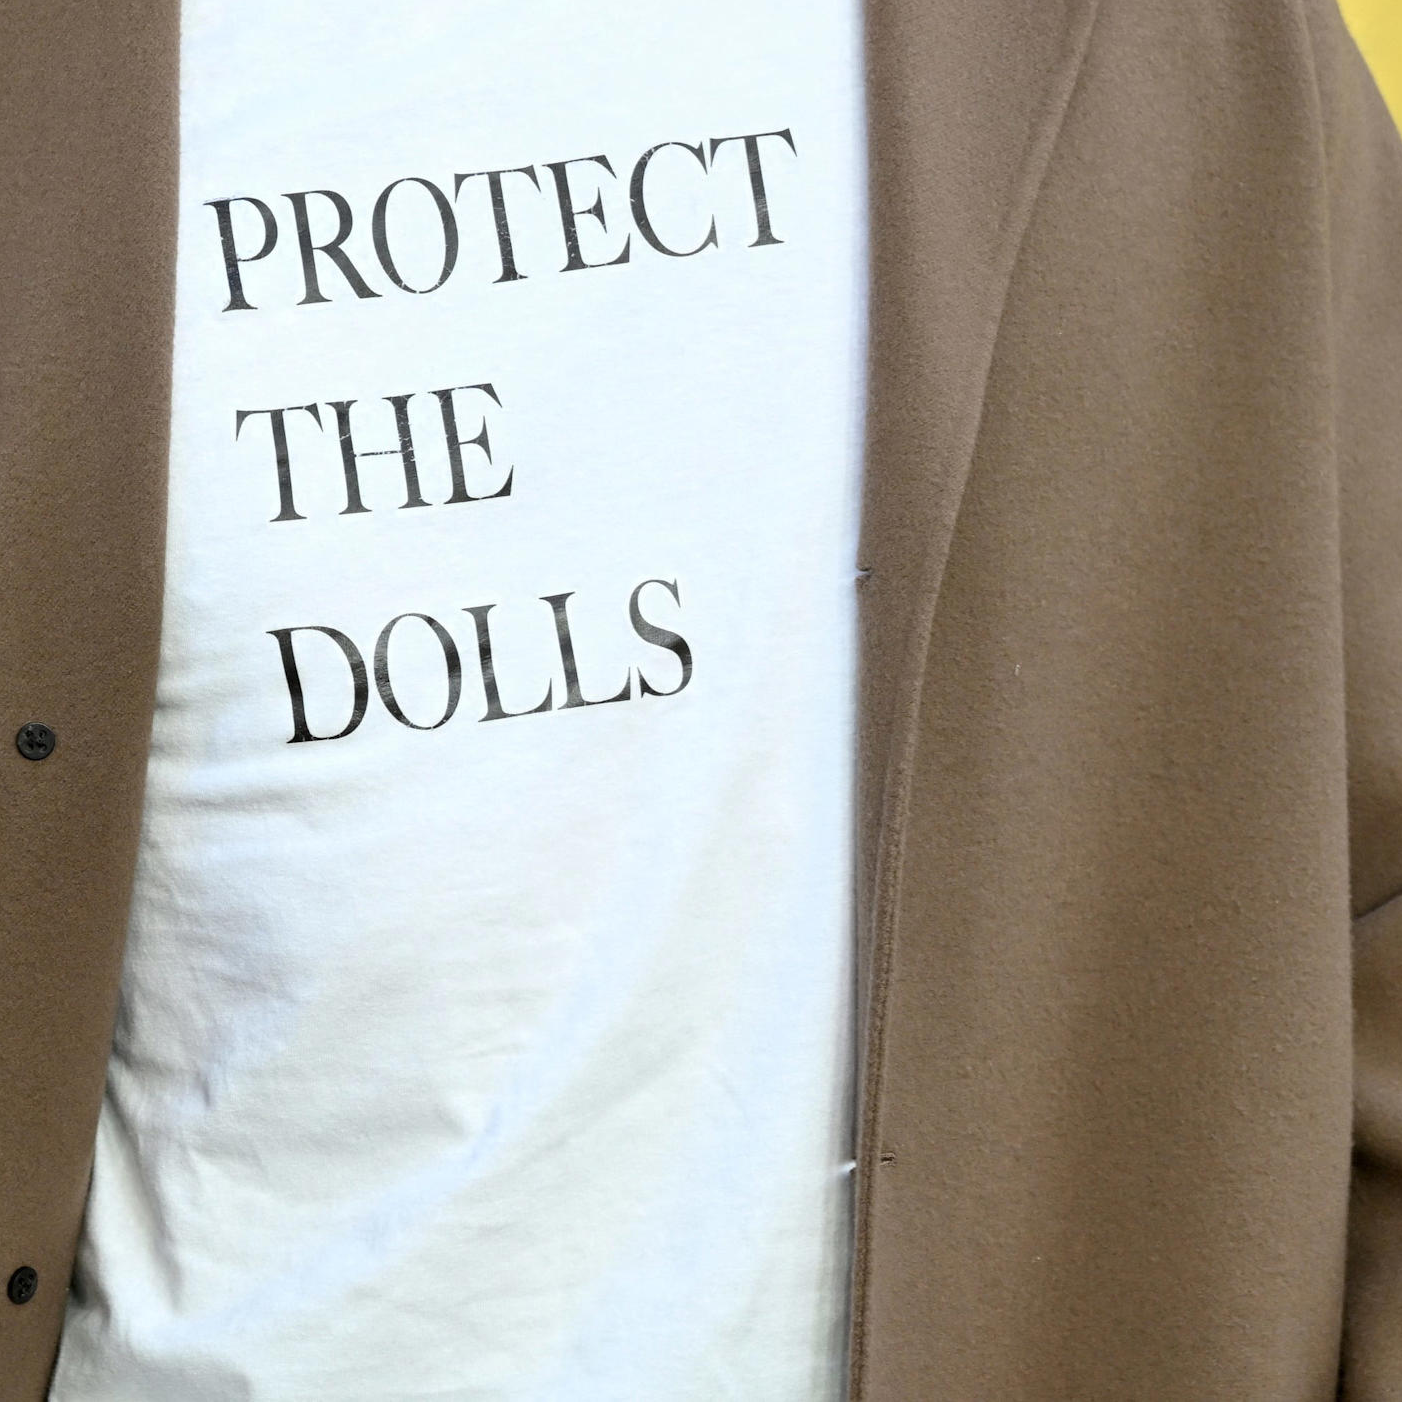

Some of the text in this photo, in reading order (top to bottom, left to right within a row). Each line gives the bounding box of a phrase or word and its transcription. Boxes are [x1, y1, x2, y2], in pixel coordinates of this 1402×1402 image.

[202, 127, 798, 313] PROTECT
[235, 382, 515, 523] THE
[265, 578, 694, 745] DOLLS
